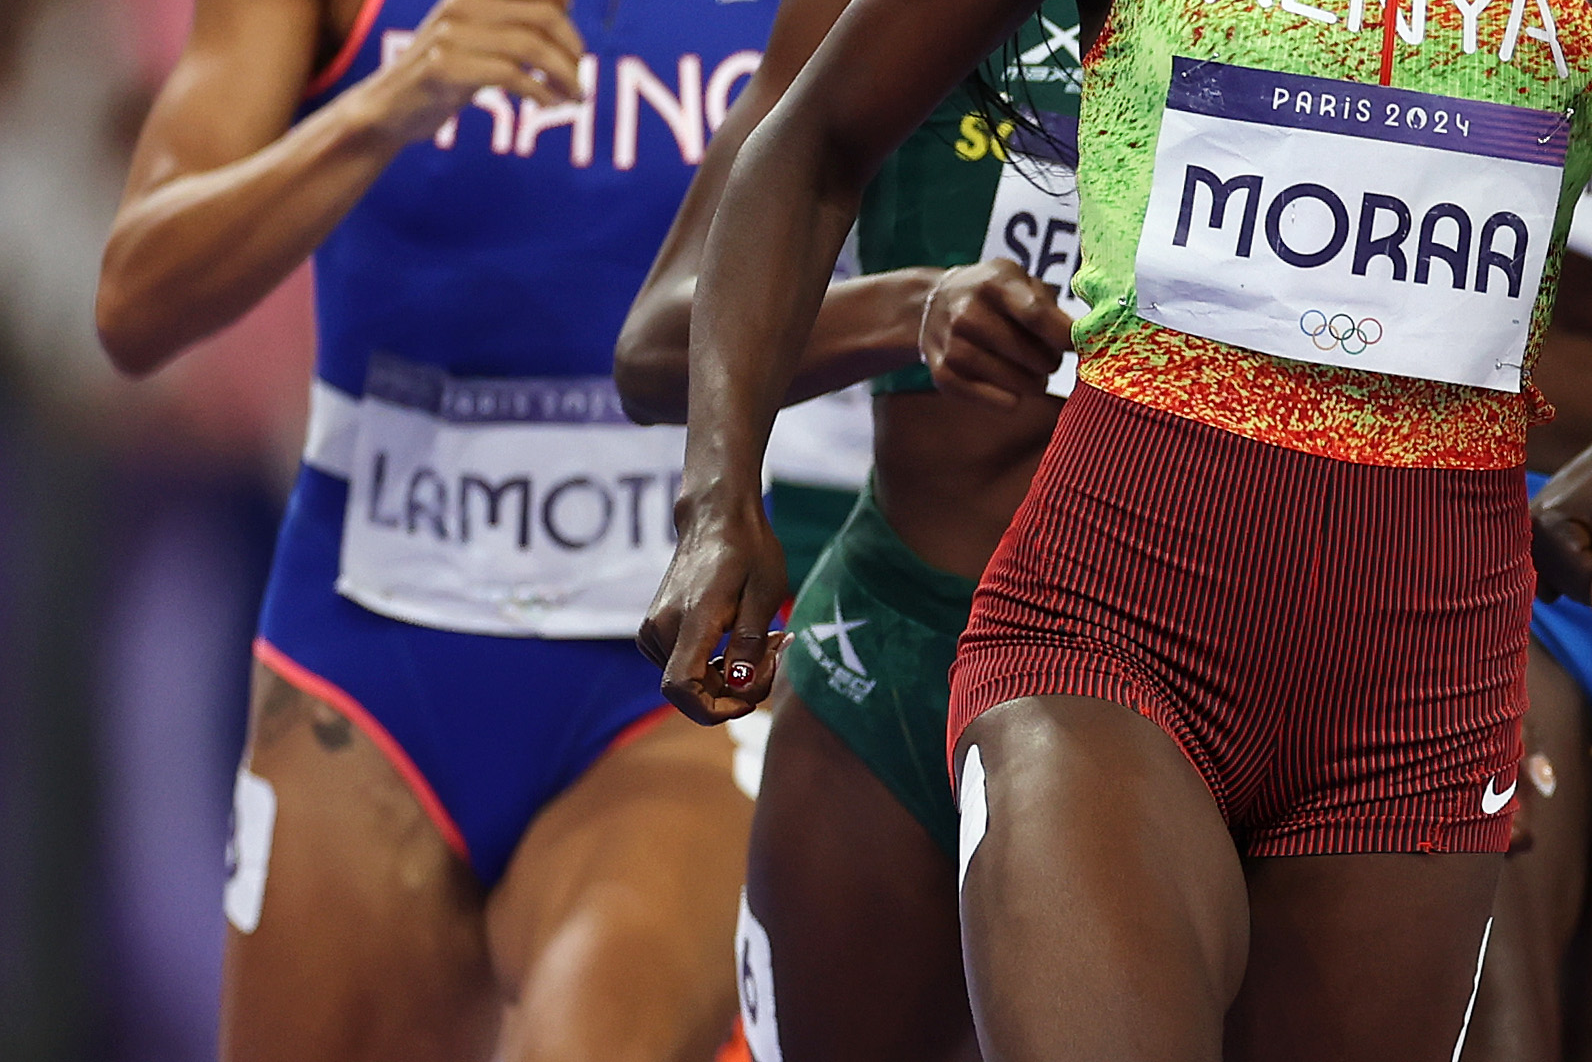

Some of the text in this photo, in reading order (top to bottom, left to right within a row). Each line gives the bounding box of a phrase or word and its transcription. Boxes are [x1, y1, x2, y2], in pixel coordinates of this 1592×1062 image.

[1384, 104, 1471, 137] 2024
[1004, 211, 1078, 300] SE
[1172, 164, 1529, 299] MORAA
